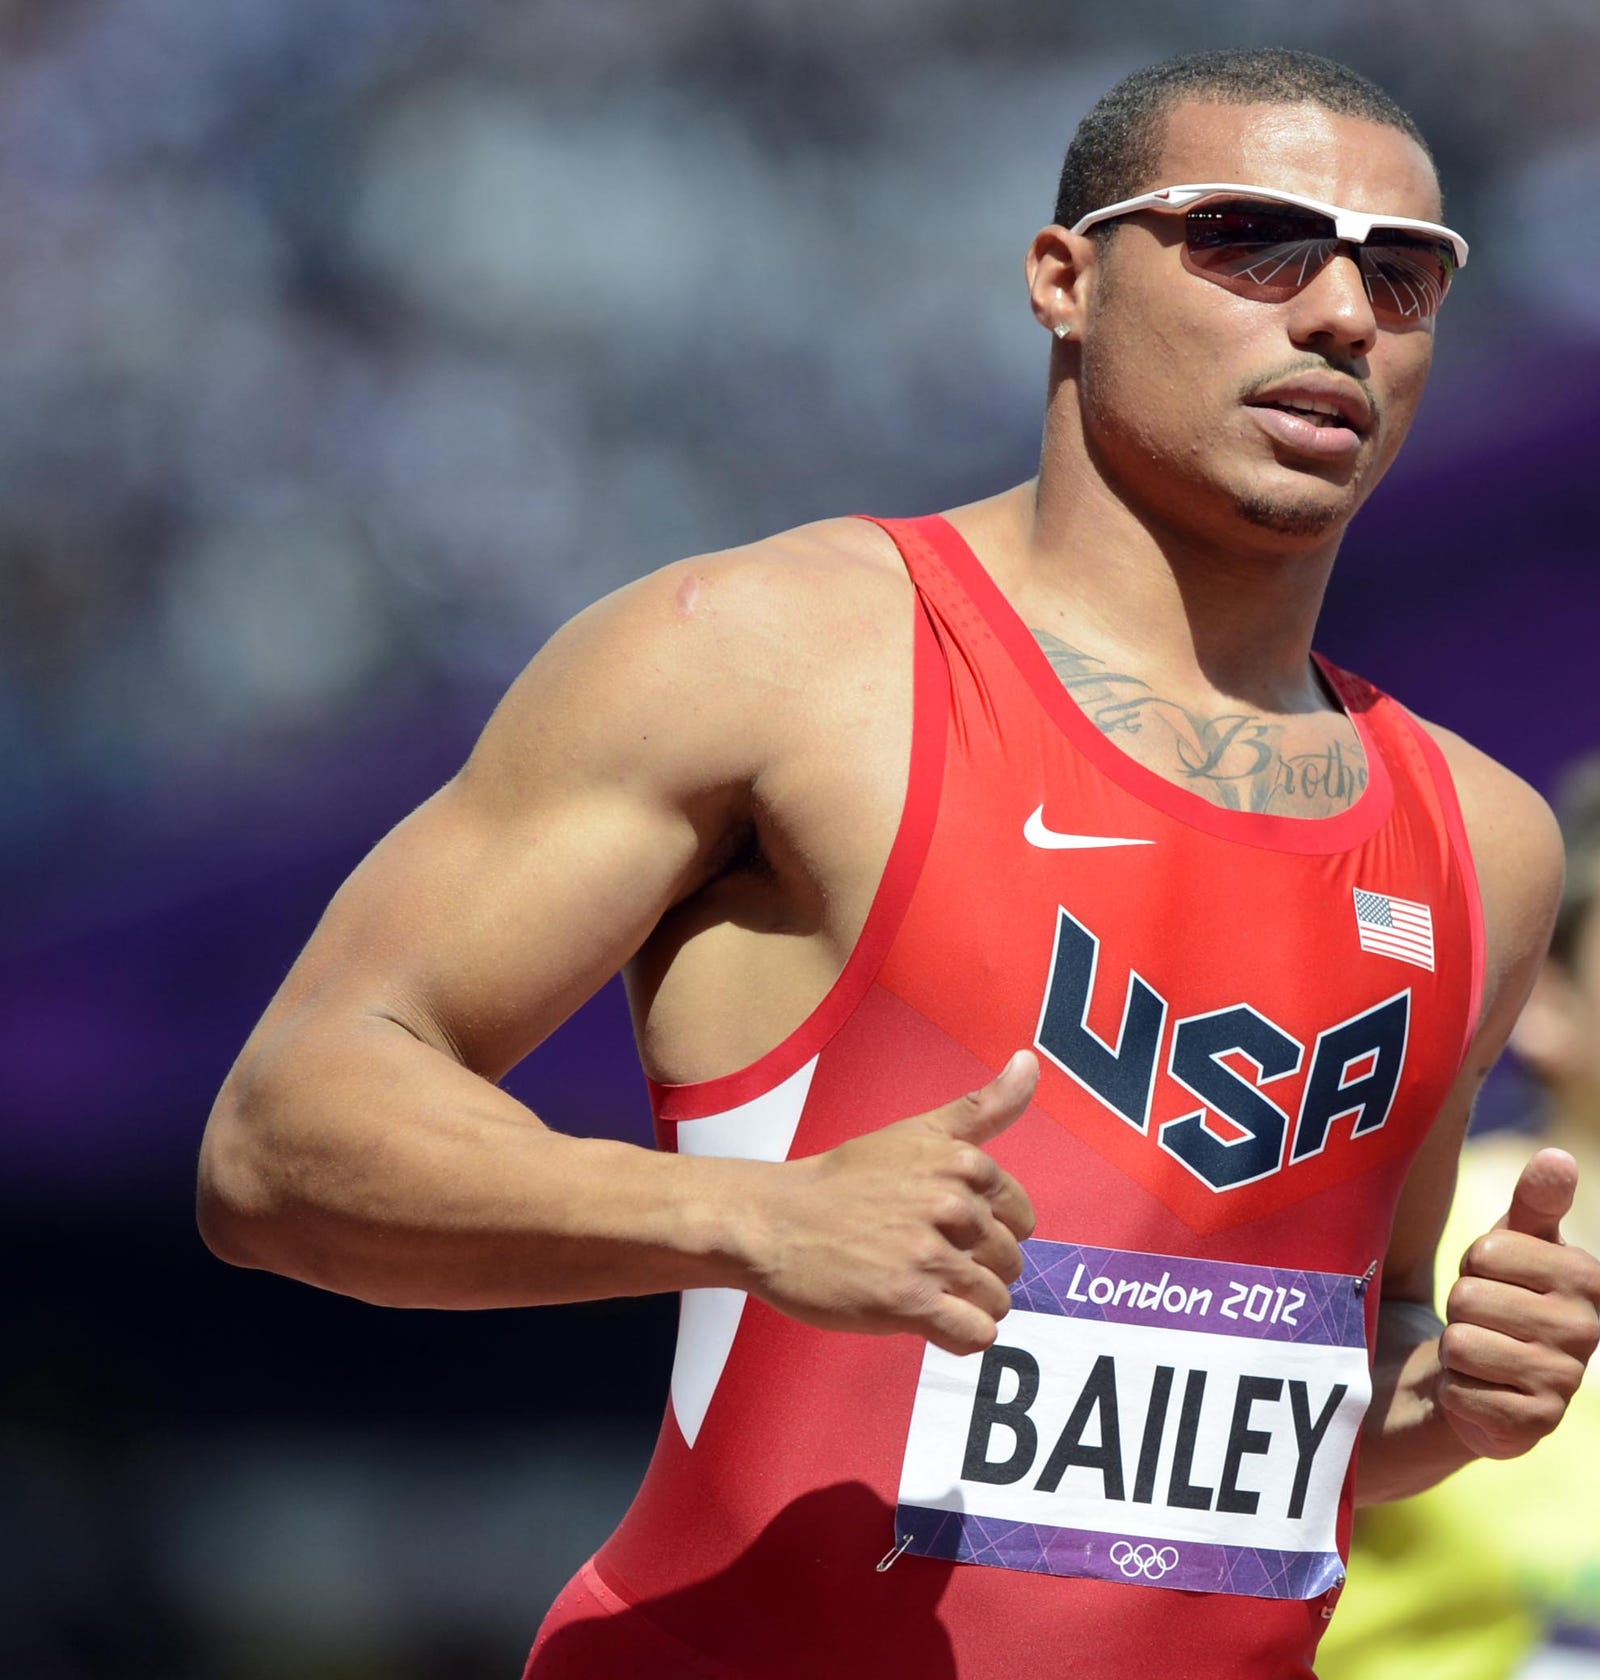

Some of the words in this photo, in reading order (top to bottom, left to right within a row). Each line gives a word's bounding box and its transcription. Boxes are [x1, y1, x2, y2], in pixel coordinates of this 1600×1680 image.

[1033, 903, 1411, 1194] USA
[1066, 1263, 1213, 1317] London
[1219, 1280, 1307, 1327] 2012
[959, 1343, 1349, 1520] BAILEY
